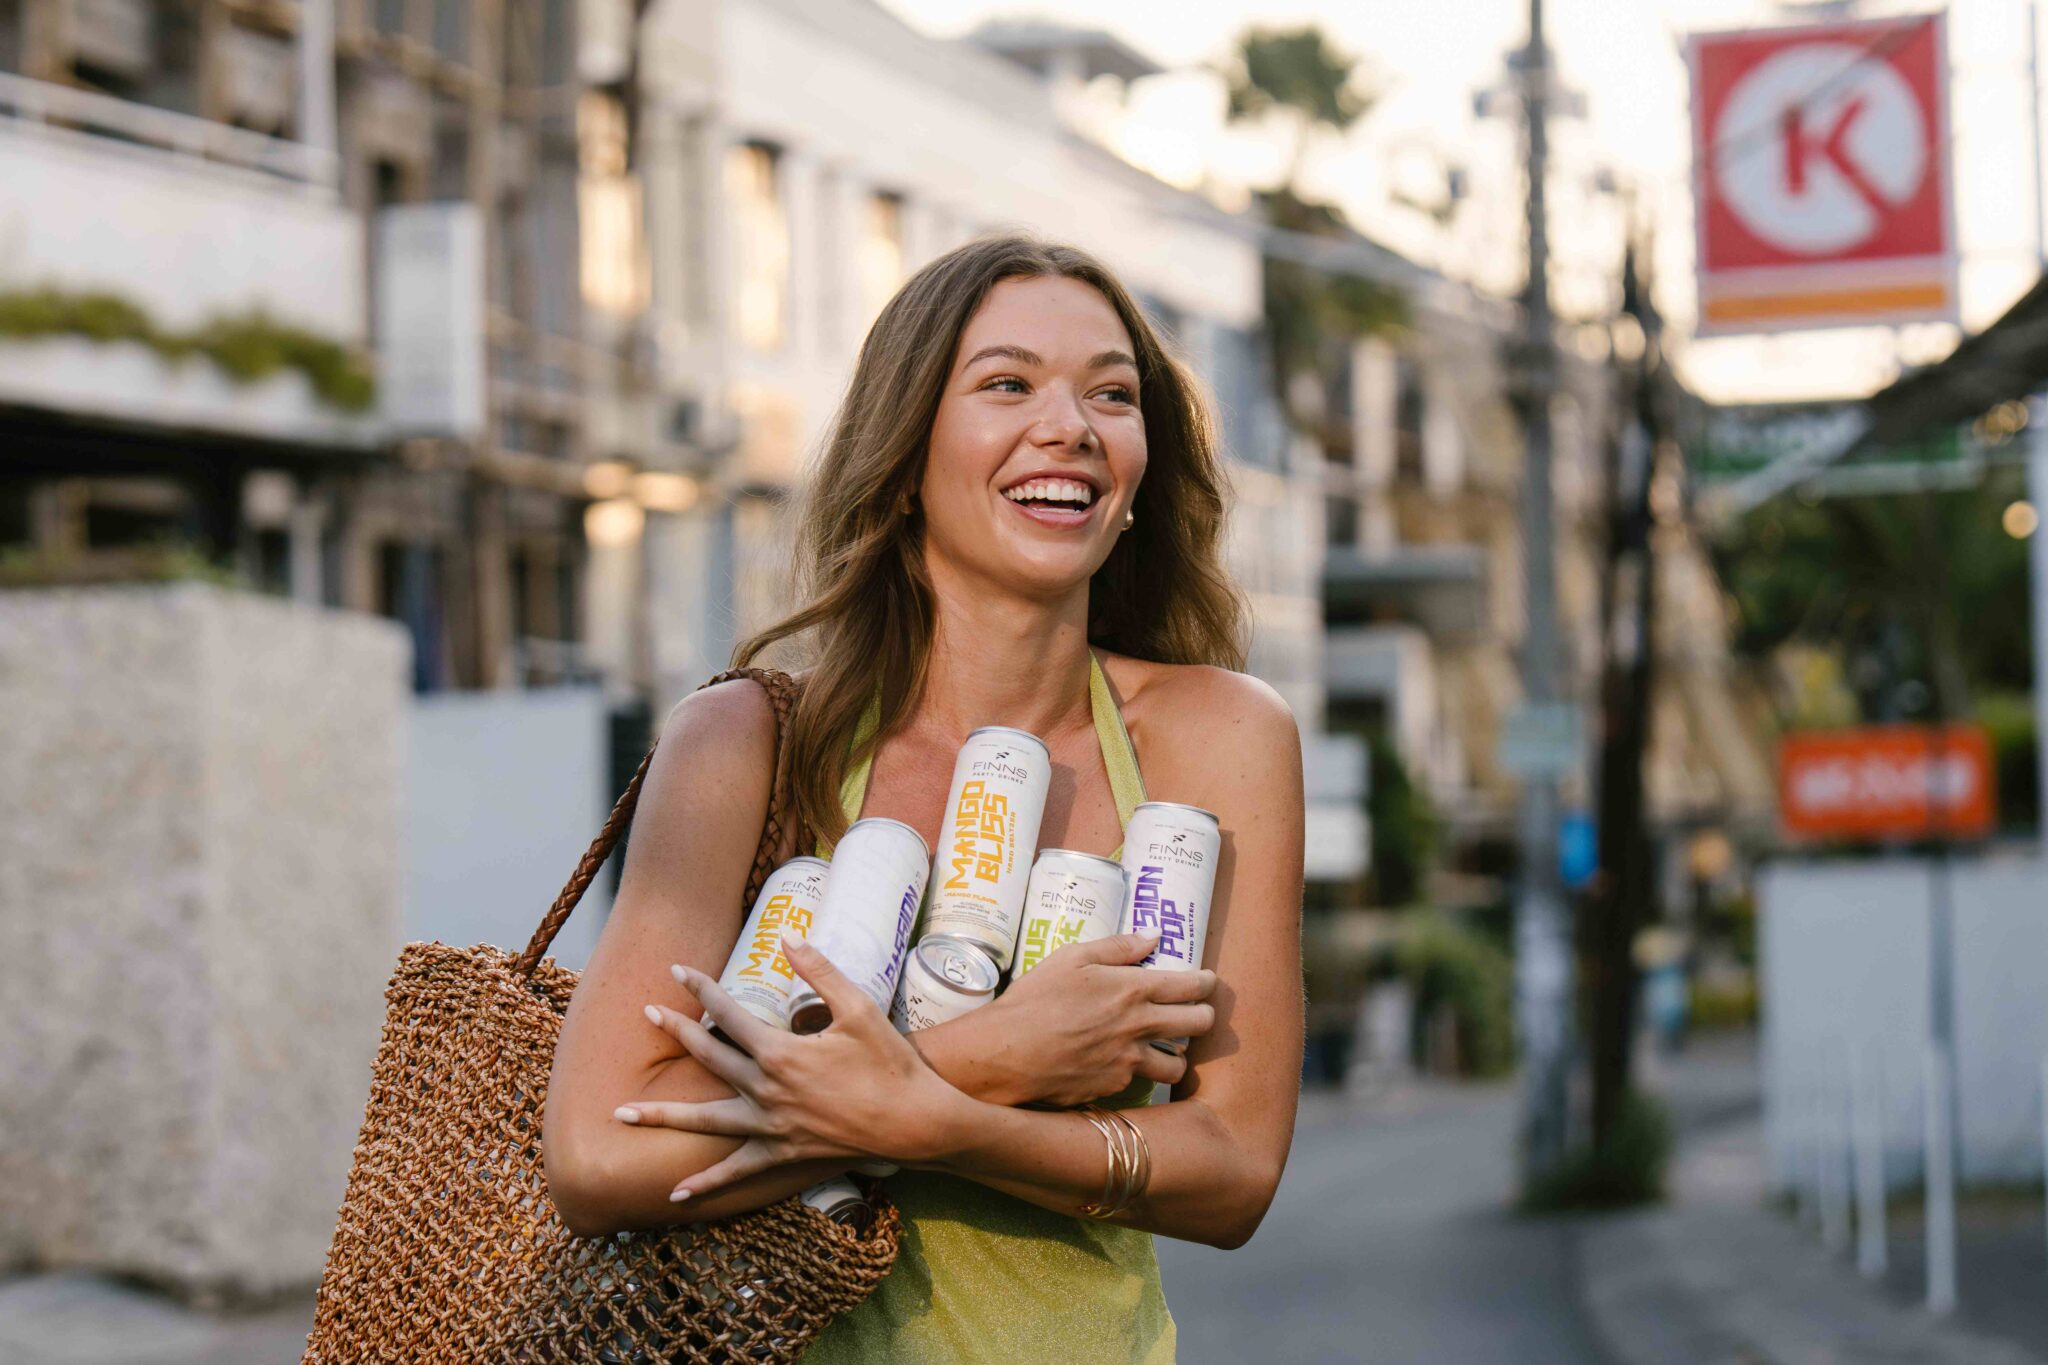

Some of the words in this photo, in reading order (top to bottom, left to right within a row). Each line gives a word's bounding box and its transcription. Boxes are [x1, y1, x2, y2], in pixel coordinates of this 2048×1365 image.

[1784, 97, 1886, 203] K
[973, 761, 1028, 779] FINNS
[998, 774, 1024, 785] DRINKS
[944, 781, 985, 889] MANGO
[975, 793, 1008, 883] BLISS
[1149, 843, 1204, 862] FINNS
[1175, 859, 1200, 869] DRINKS
[1041, 891, 1097, 910] FINNS
[1159, 899, 1186, 959] POP
[737, 895, 794, 977] MANGO
[770, 905, 813, 981] BSS
[885, 884, 919, 990] PASSION
[1187, 942, 1195, 964] HARD
